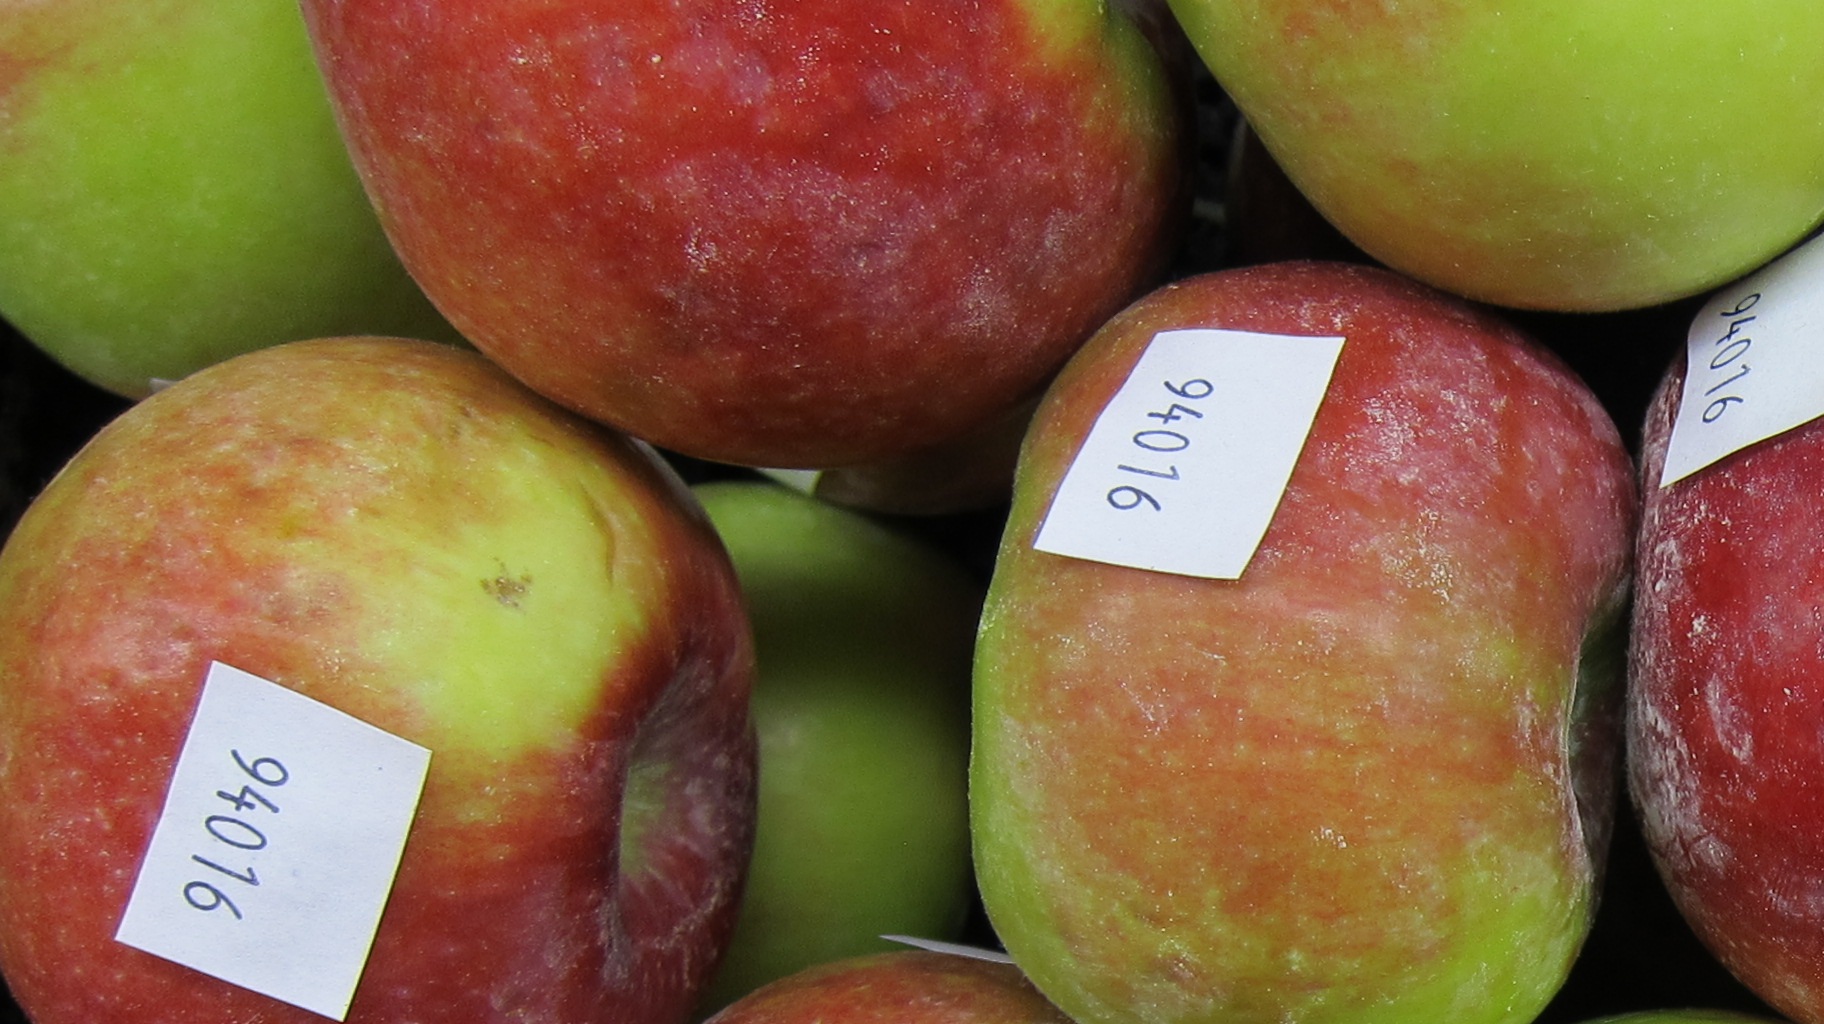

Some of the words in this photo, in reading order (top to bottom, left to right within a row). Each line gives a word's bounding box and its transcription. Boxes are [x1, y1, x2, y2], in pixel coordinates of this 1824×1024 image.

[1702, 293, 1762, 424] 94016
[1106, 378, 1214, 512] 94016
[184, 748, 290, 920] 94016
